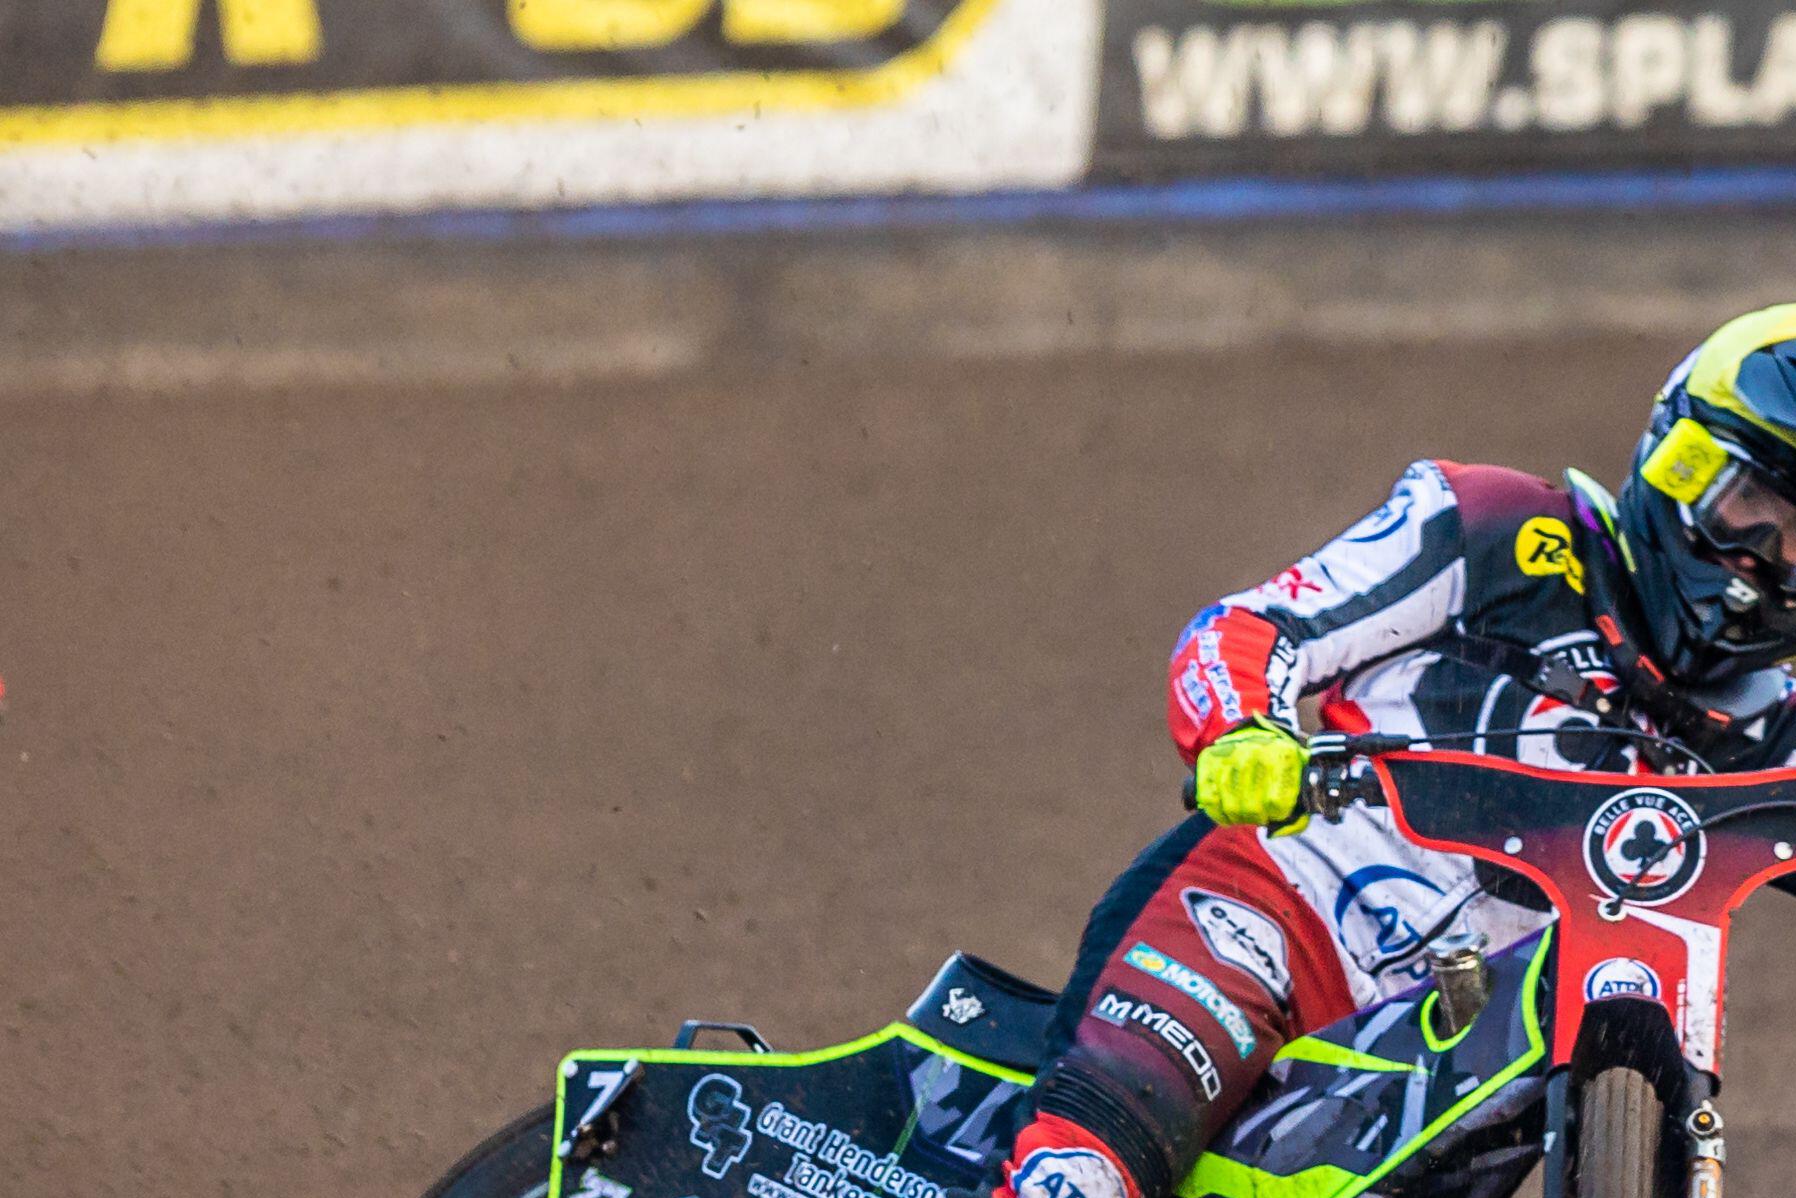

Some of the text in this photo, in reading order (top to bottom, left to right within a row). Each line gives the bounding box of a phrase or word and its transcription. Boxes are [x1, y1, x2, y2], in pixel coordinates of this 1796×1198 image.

[1593, 795, 1694, 835] BELLE VUE ACE
[1358, 902, 1434, 982] ATP
[1160, 961, 1253, 1055] MOTOREX
[756, 1100, 828, 1154] Grant
